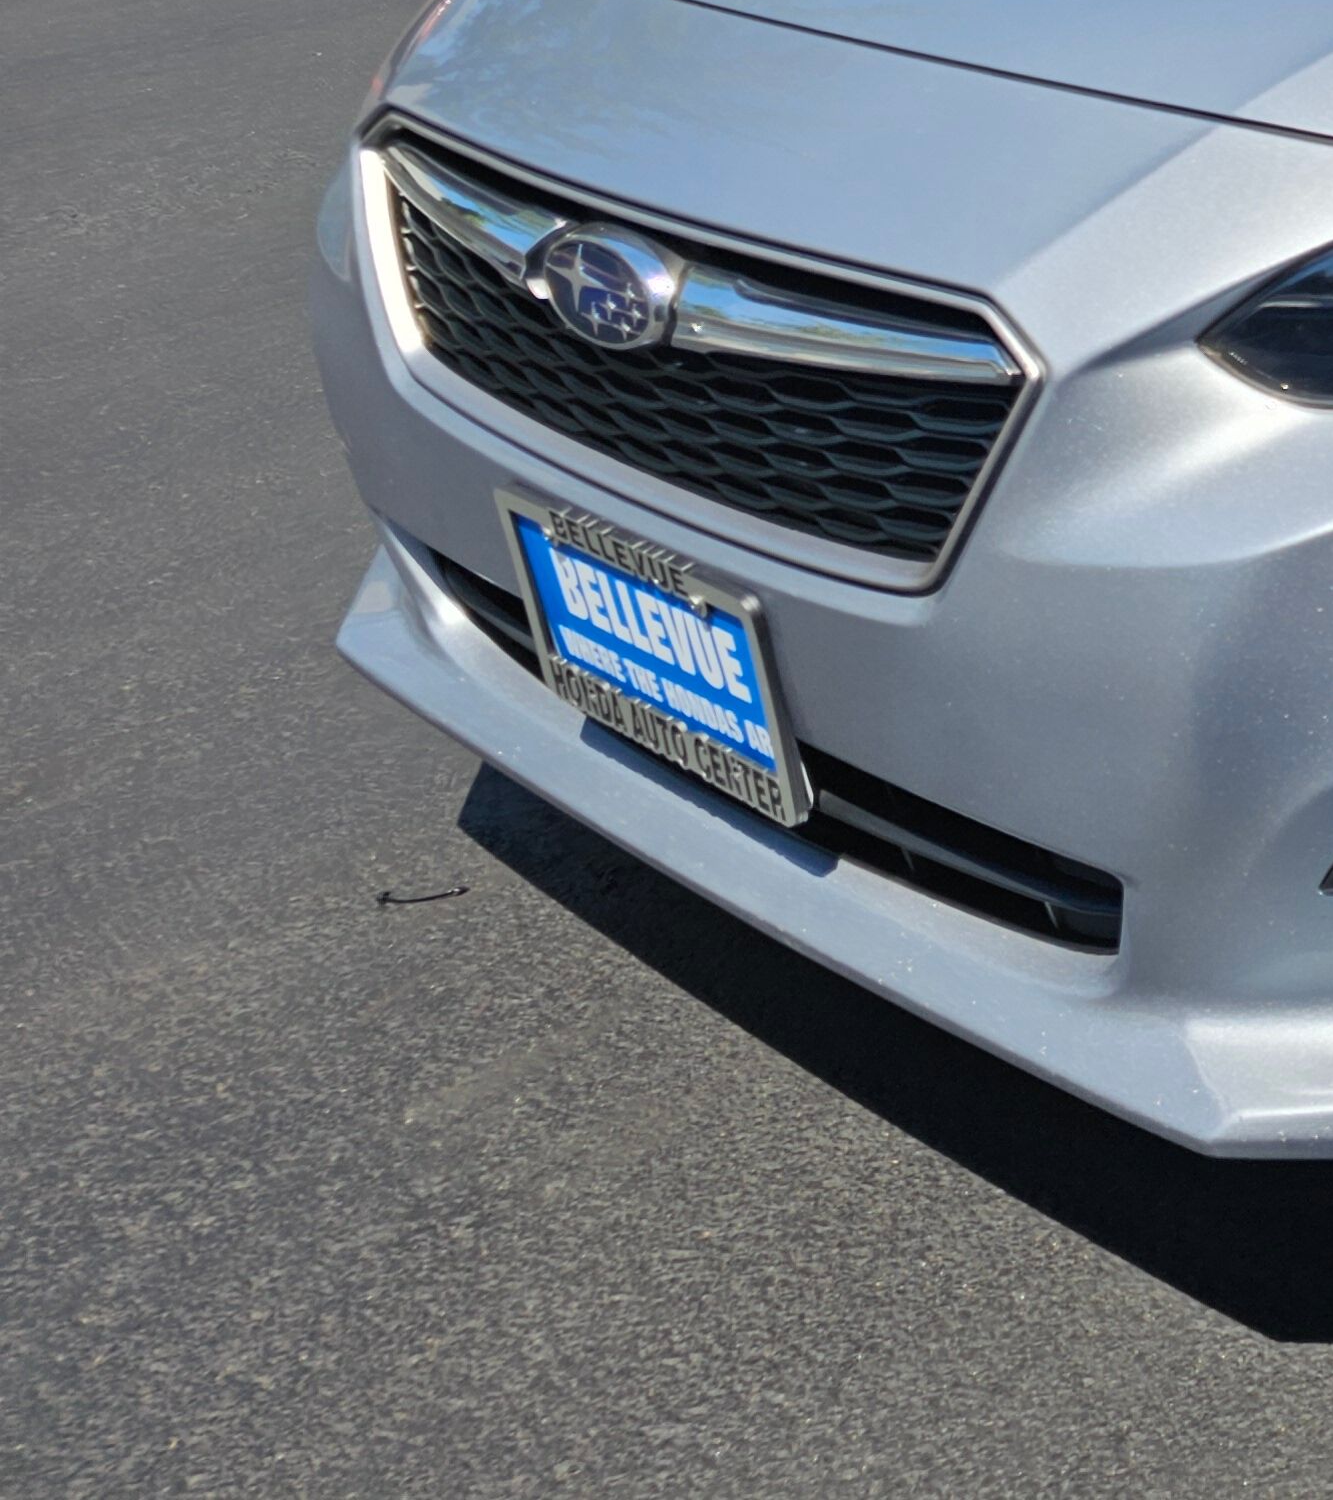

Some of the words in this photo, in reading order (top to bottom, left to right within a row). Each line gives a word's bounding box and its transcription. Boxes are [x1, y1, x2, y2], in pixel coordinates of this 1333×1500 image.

[548, 547, 753, 705] BELLEVUE
[549, 510, 689, 597] BELLEVUE
[550, 656, 628, 734] HONDA
[631, 698, 689, 768] AUTO
[694, 733, 787, 822] CENTER
[558, 623, 627, 684] WHERE
[622, 657, 664, 703] THE
[660, 677, 745, 744] HONDAS
[744, 718, 776, 760] AR
